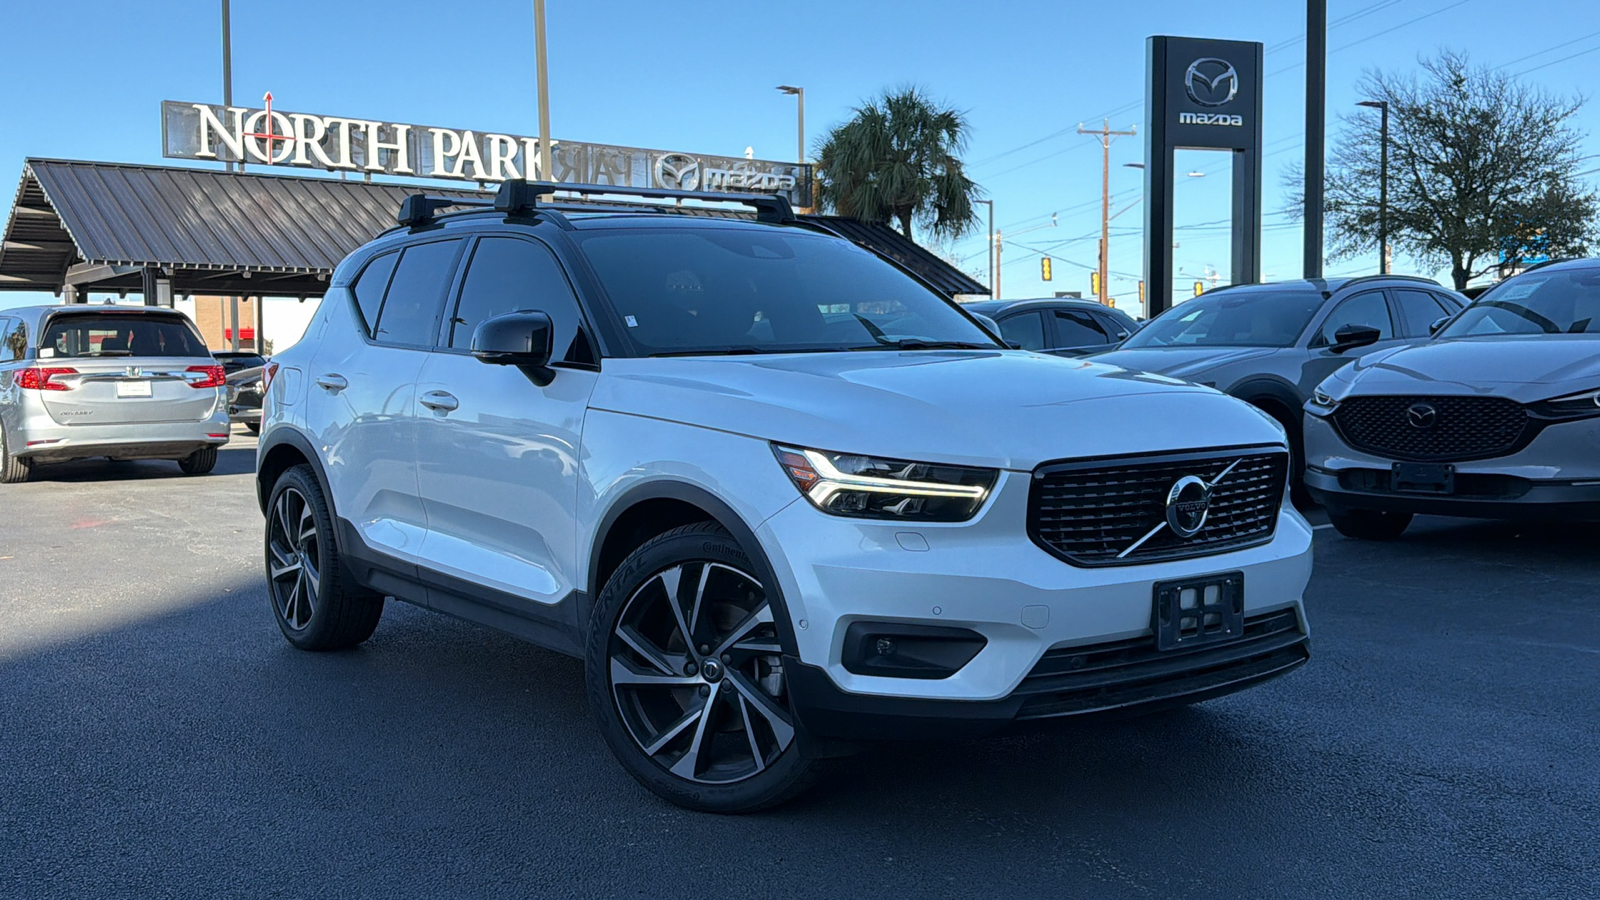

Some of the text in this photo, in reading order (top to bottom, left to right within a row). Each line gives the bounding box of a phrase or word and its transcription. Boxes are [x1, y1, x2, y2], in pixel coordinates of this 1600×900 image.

[1179, 112, 1243, 126] mazda
[193, 104, 559, 183] NORTH PARK
[703, 168, 796, 193] mazda
[1177, 502, 1206, 512] VOLVO
[702, 541, 750, 562] Continenta
